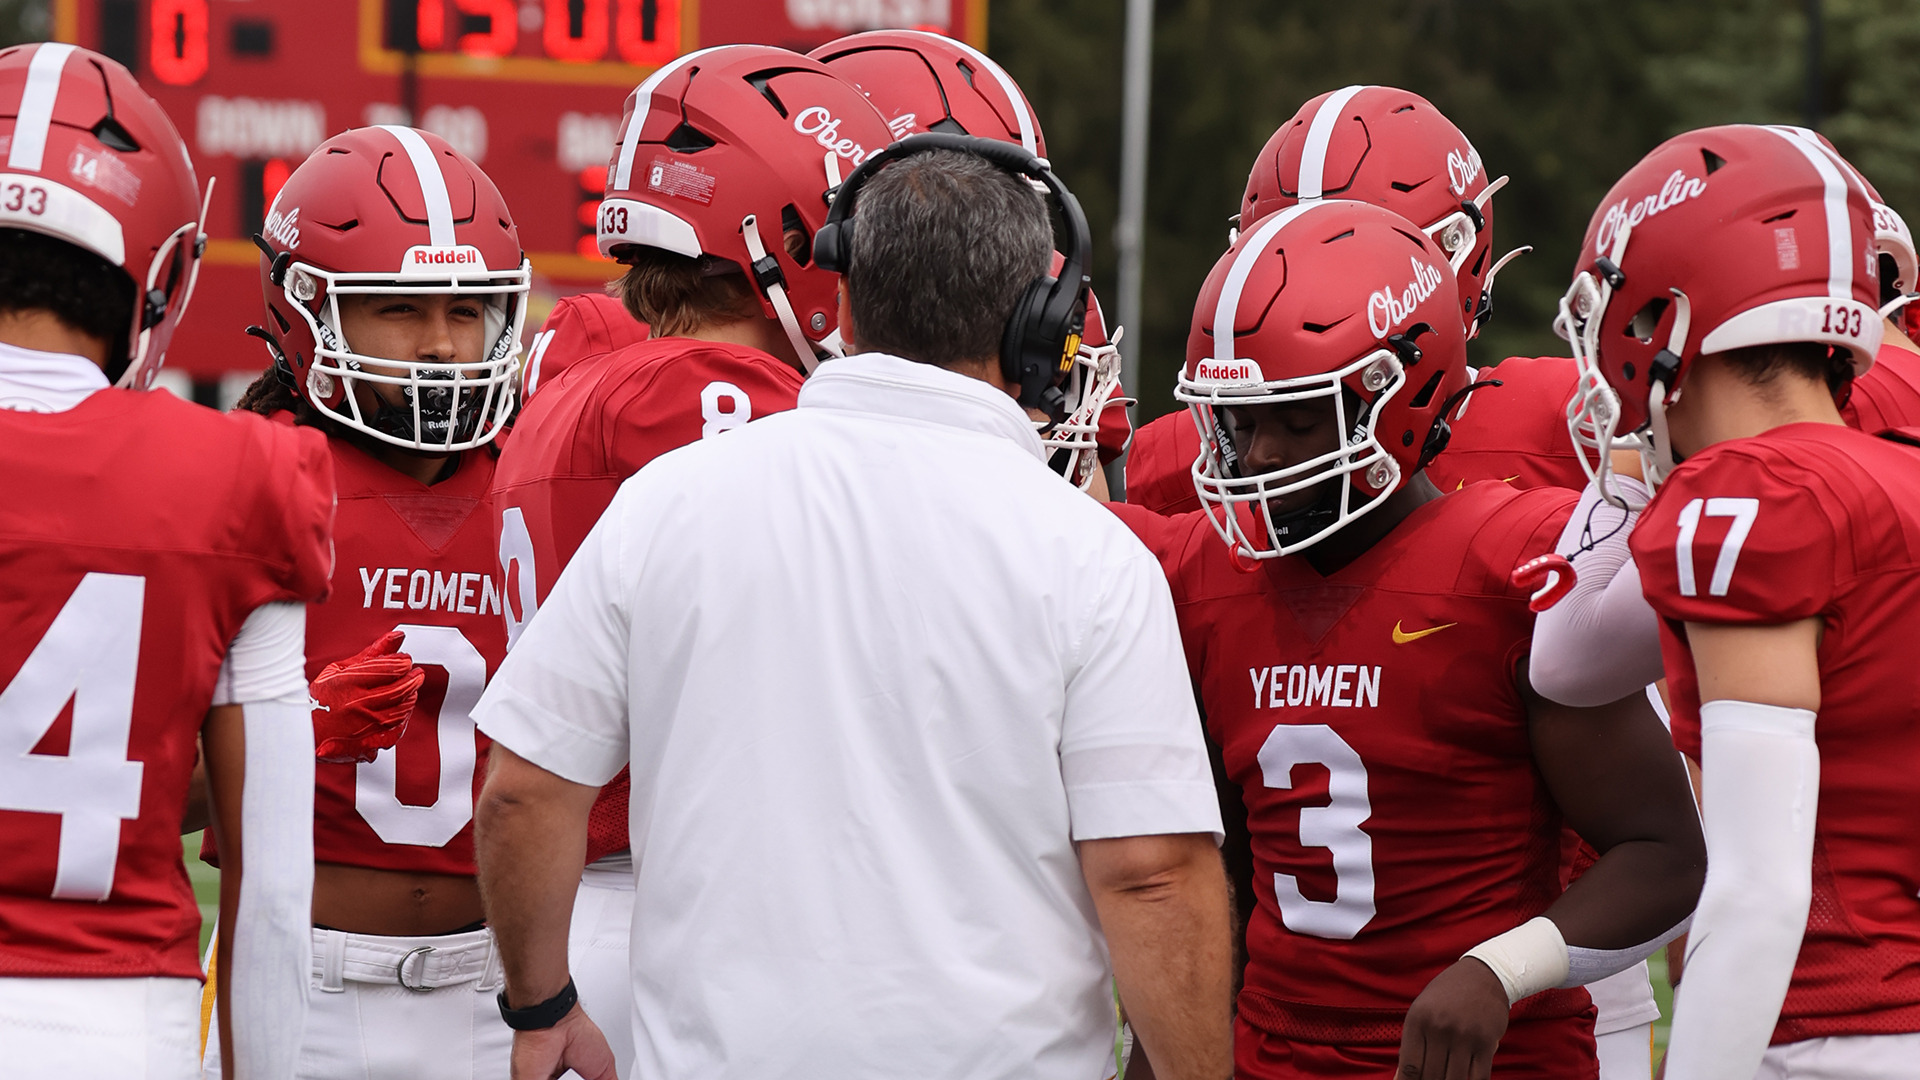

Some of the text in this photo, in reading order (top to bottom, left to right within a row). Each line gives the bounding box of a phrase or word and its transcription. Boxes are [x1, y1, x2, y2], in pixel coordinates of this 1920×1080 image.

[794, 106, 885, 167] Ober
[71, 152, 98, 181] 14
[0, 183, 48, 215] 33
[414, 250, 476, 264] Riddell
[1367, 256, 1442, 339] Oberlin
[1821, 304, 1862, 337] 133
[1200, 364, 1249, 380] Riddell
[1676, 497, 1760, 596] 17
[358, 567, 501, 616] YEOMEN
[1249, 664, 1382, 709] YEOMEN
[355, 624, 486, 848] 0
[1256, 724, 1377, 940] 3
